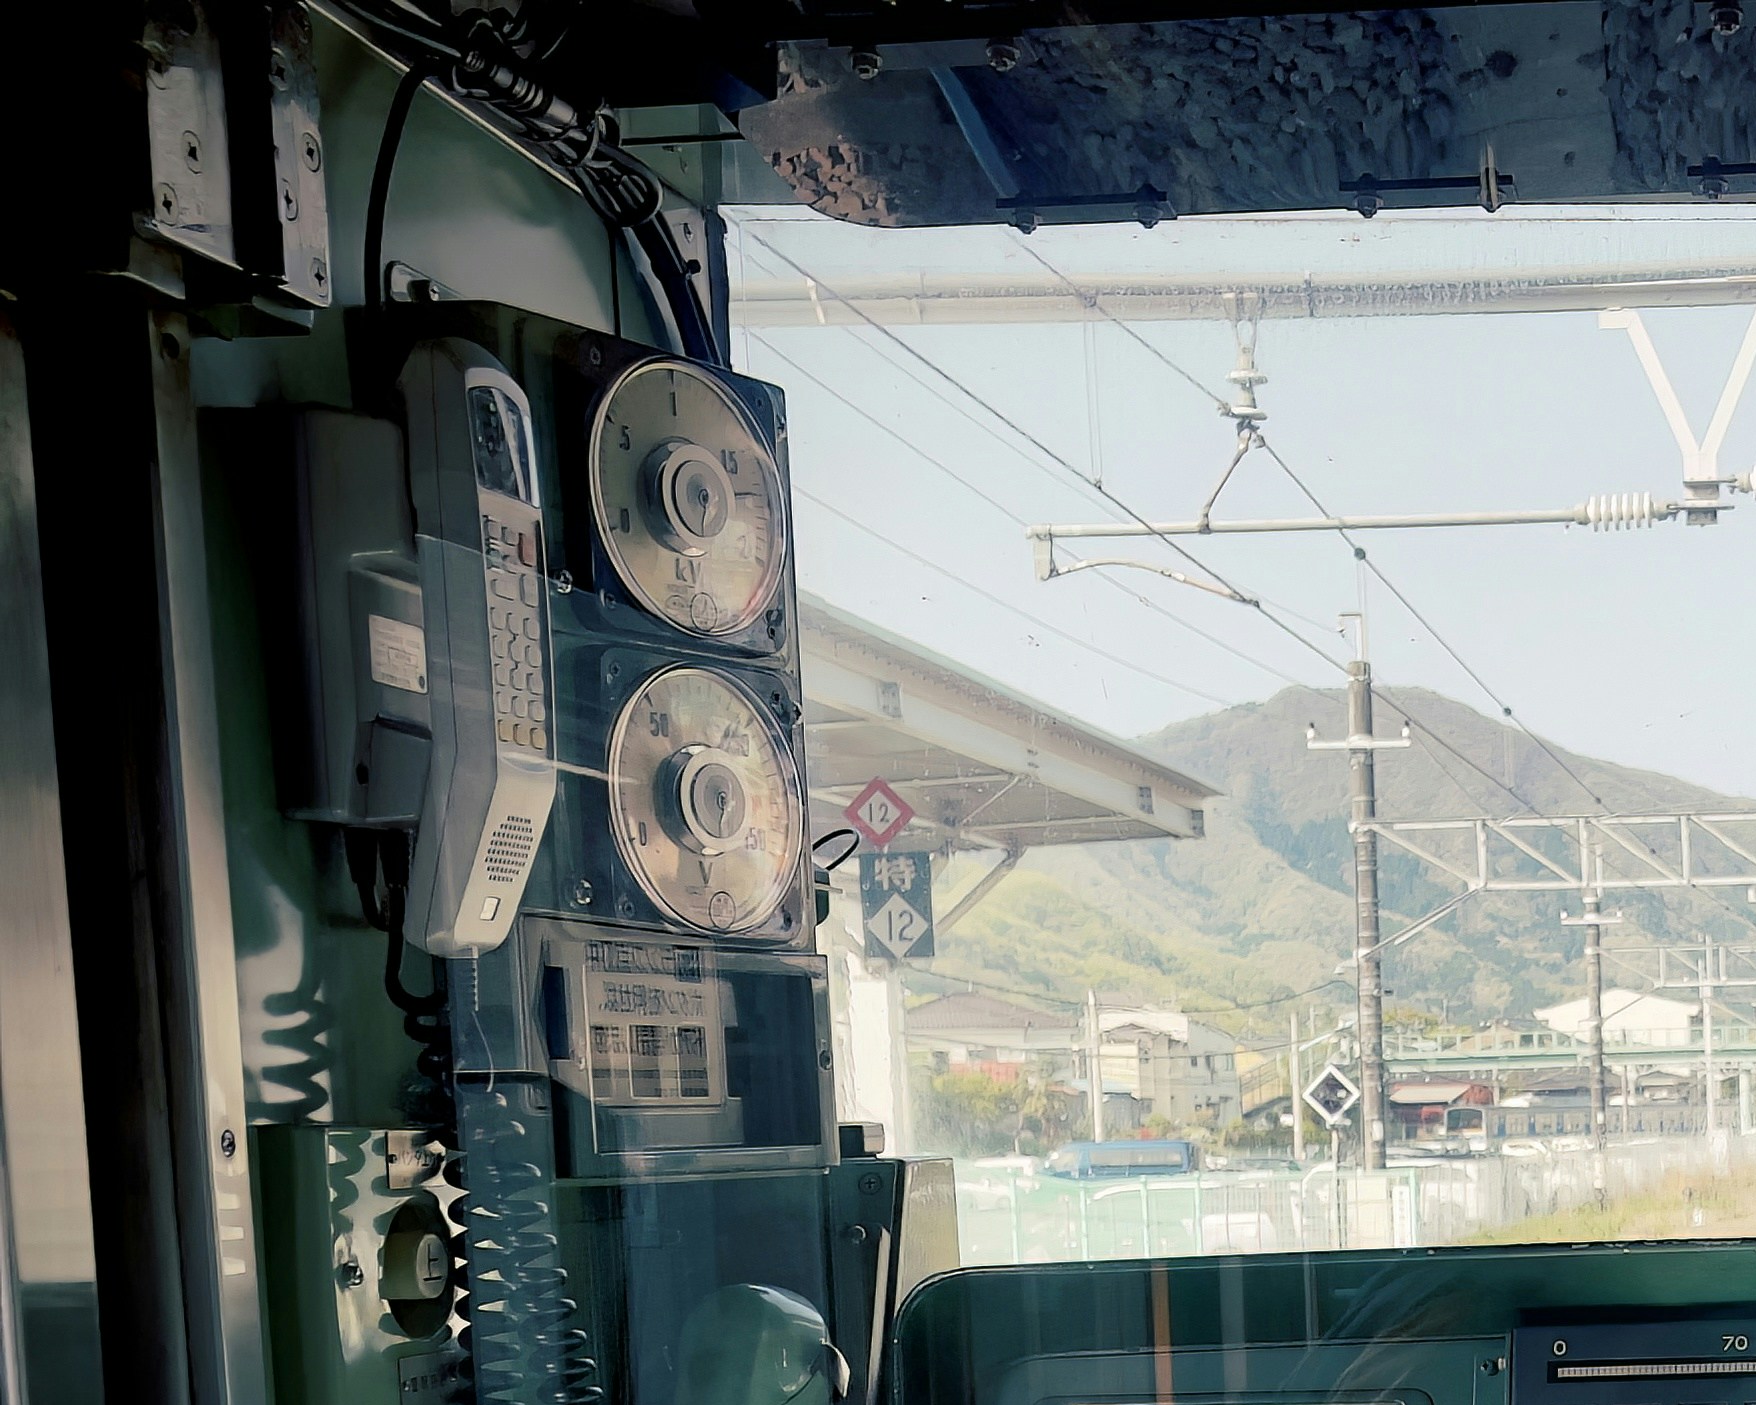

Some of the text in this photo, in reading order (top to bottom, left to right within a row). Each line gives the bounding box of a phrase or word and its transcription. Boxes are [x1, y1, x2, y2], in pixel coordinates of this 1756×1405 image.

[649, 712, 669, 737] 50
[869, 802, 890, 823] 12
[874, 855, 916, 891] 特
[887, 909, 915, 942] 12
[1553, 1340, 1567, 1356] 0
[1721, 1335, 1749, 1352] 70
